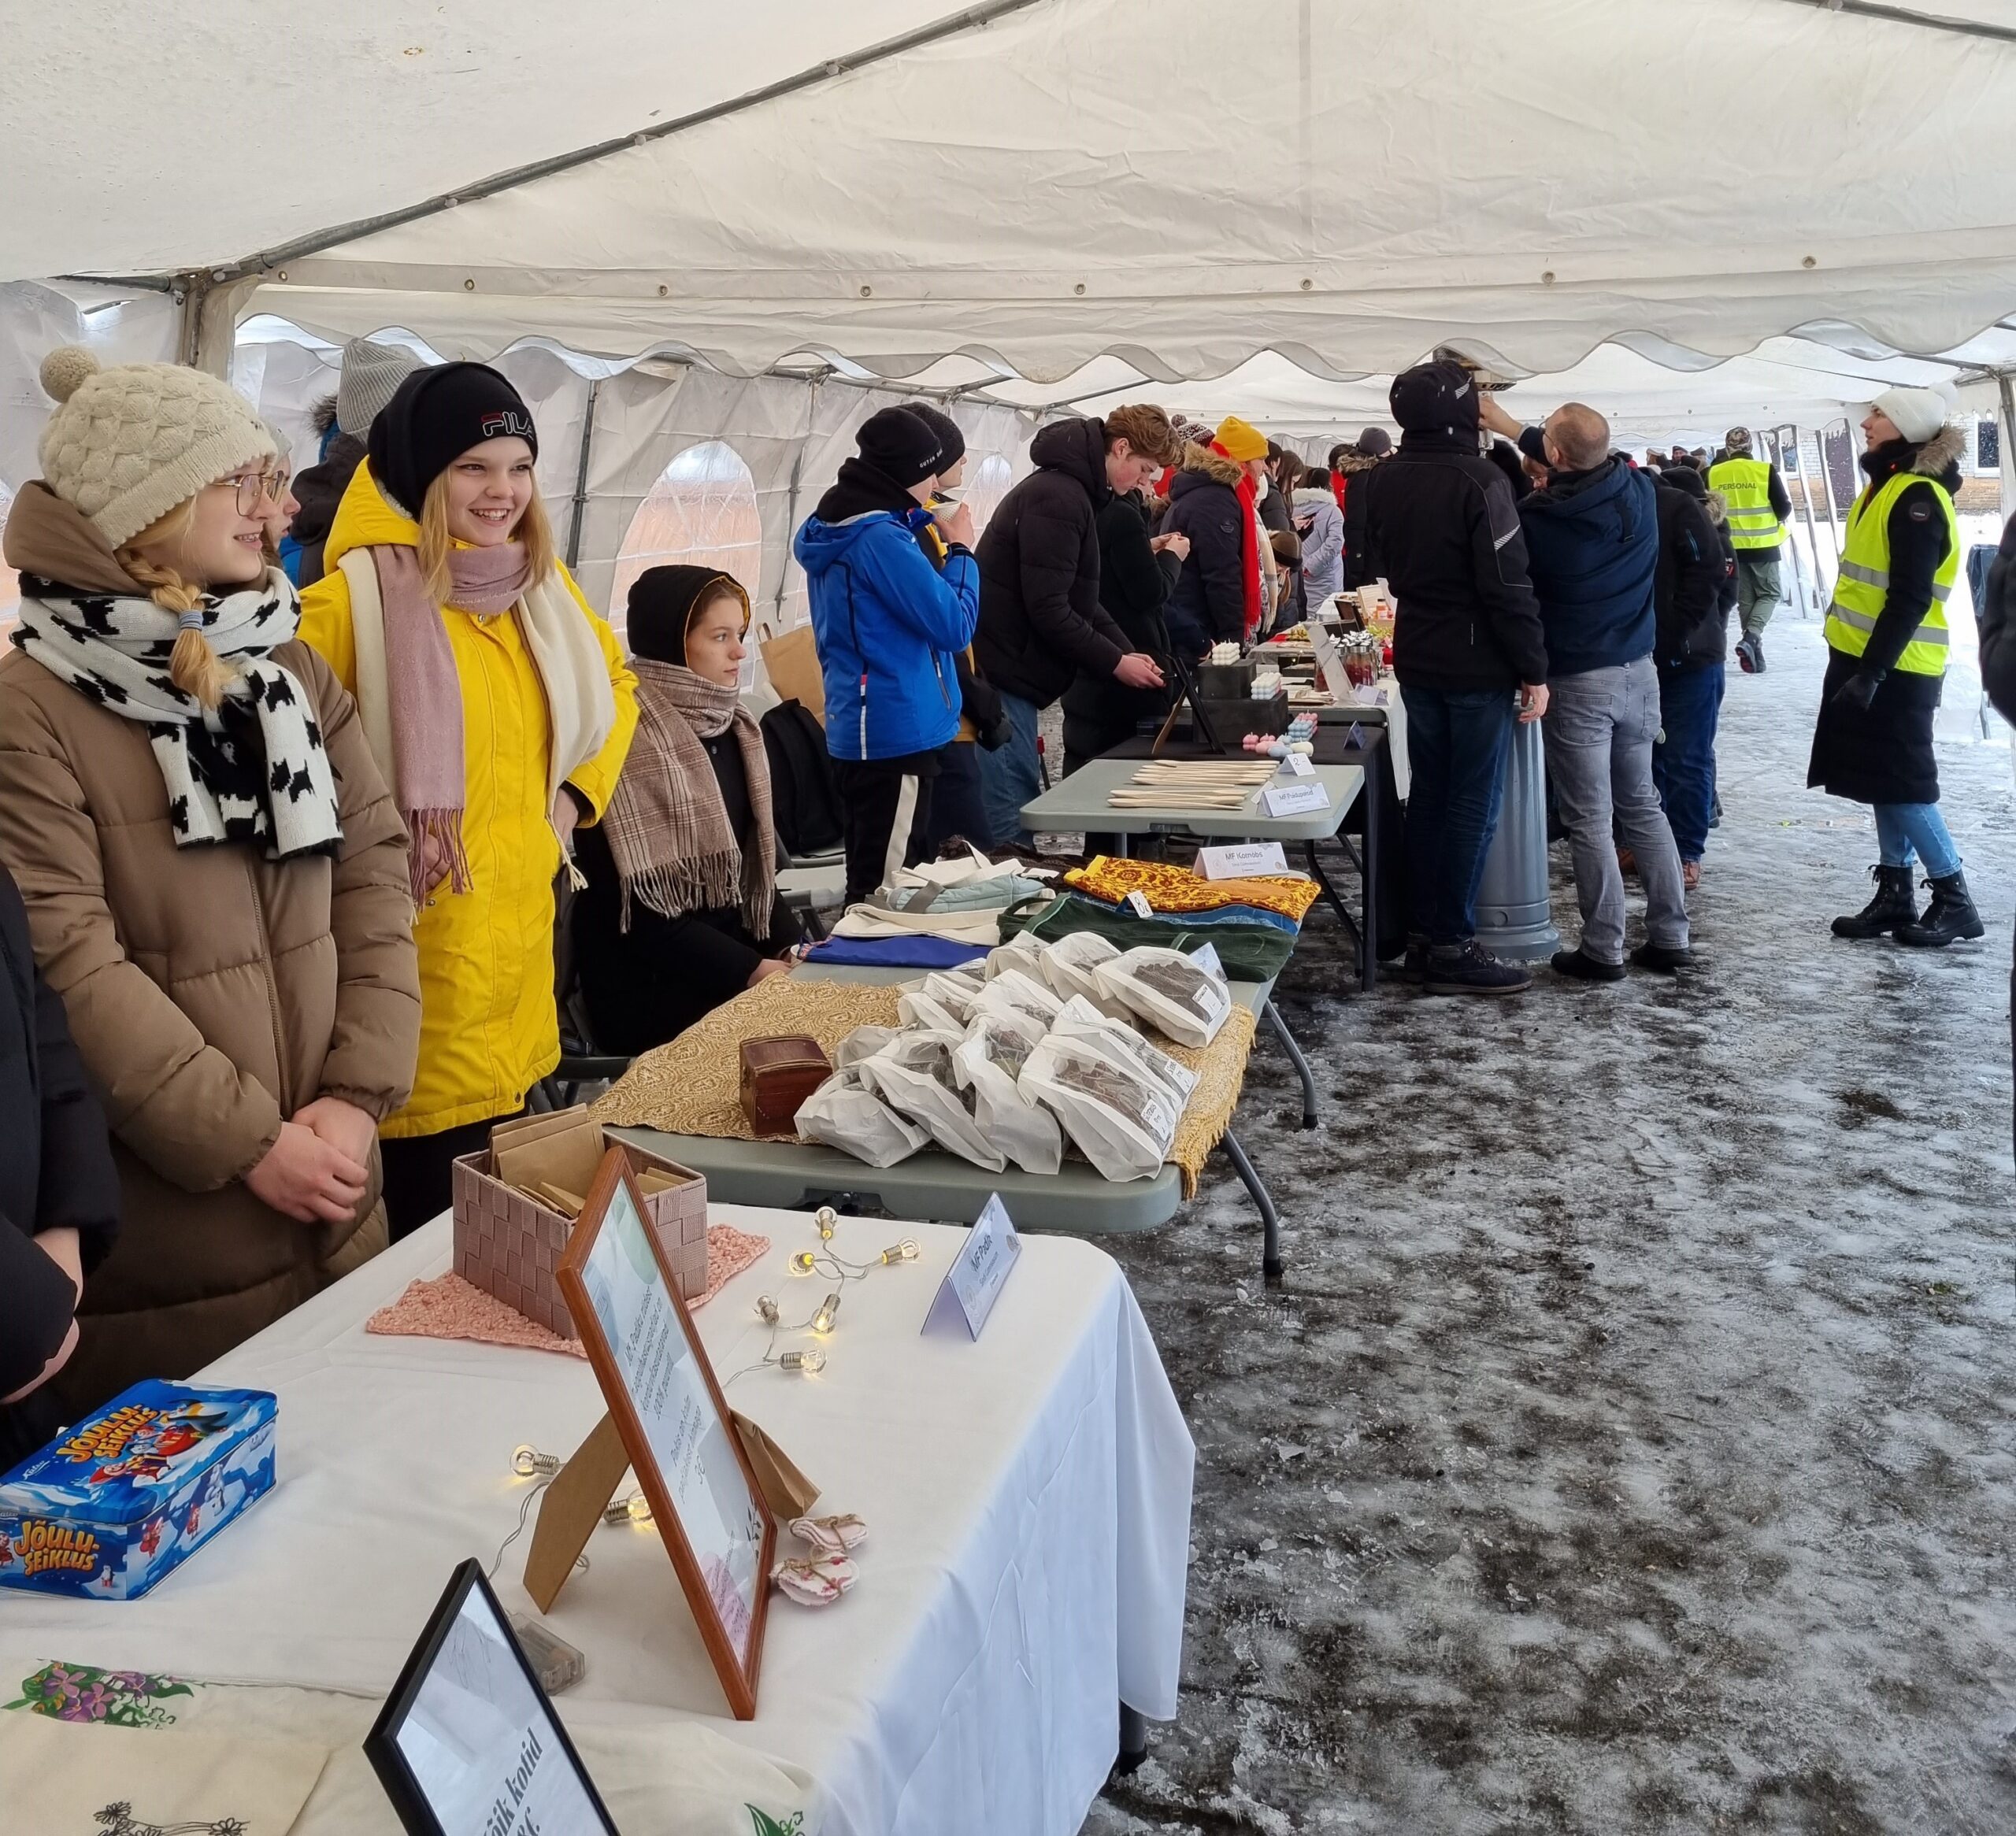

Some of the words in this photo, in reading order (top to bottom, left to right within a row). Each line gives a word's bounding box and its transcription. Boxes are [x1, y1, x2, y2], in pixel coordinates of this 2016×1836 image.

[1718, 482, 1758, 491] PERSONAL
[1225, 852, 1236, 861] MF
[970, 1251, 980, 1272] MF
[56, 1405, 143, 1463] JÕULU-
[14, 1520, 100, 1556] JÕULU-
[483, 1798, 516, 1836] õik
[505, 1726, 543, 1808] kotid
